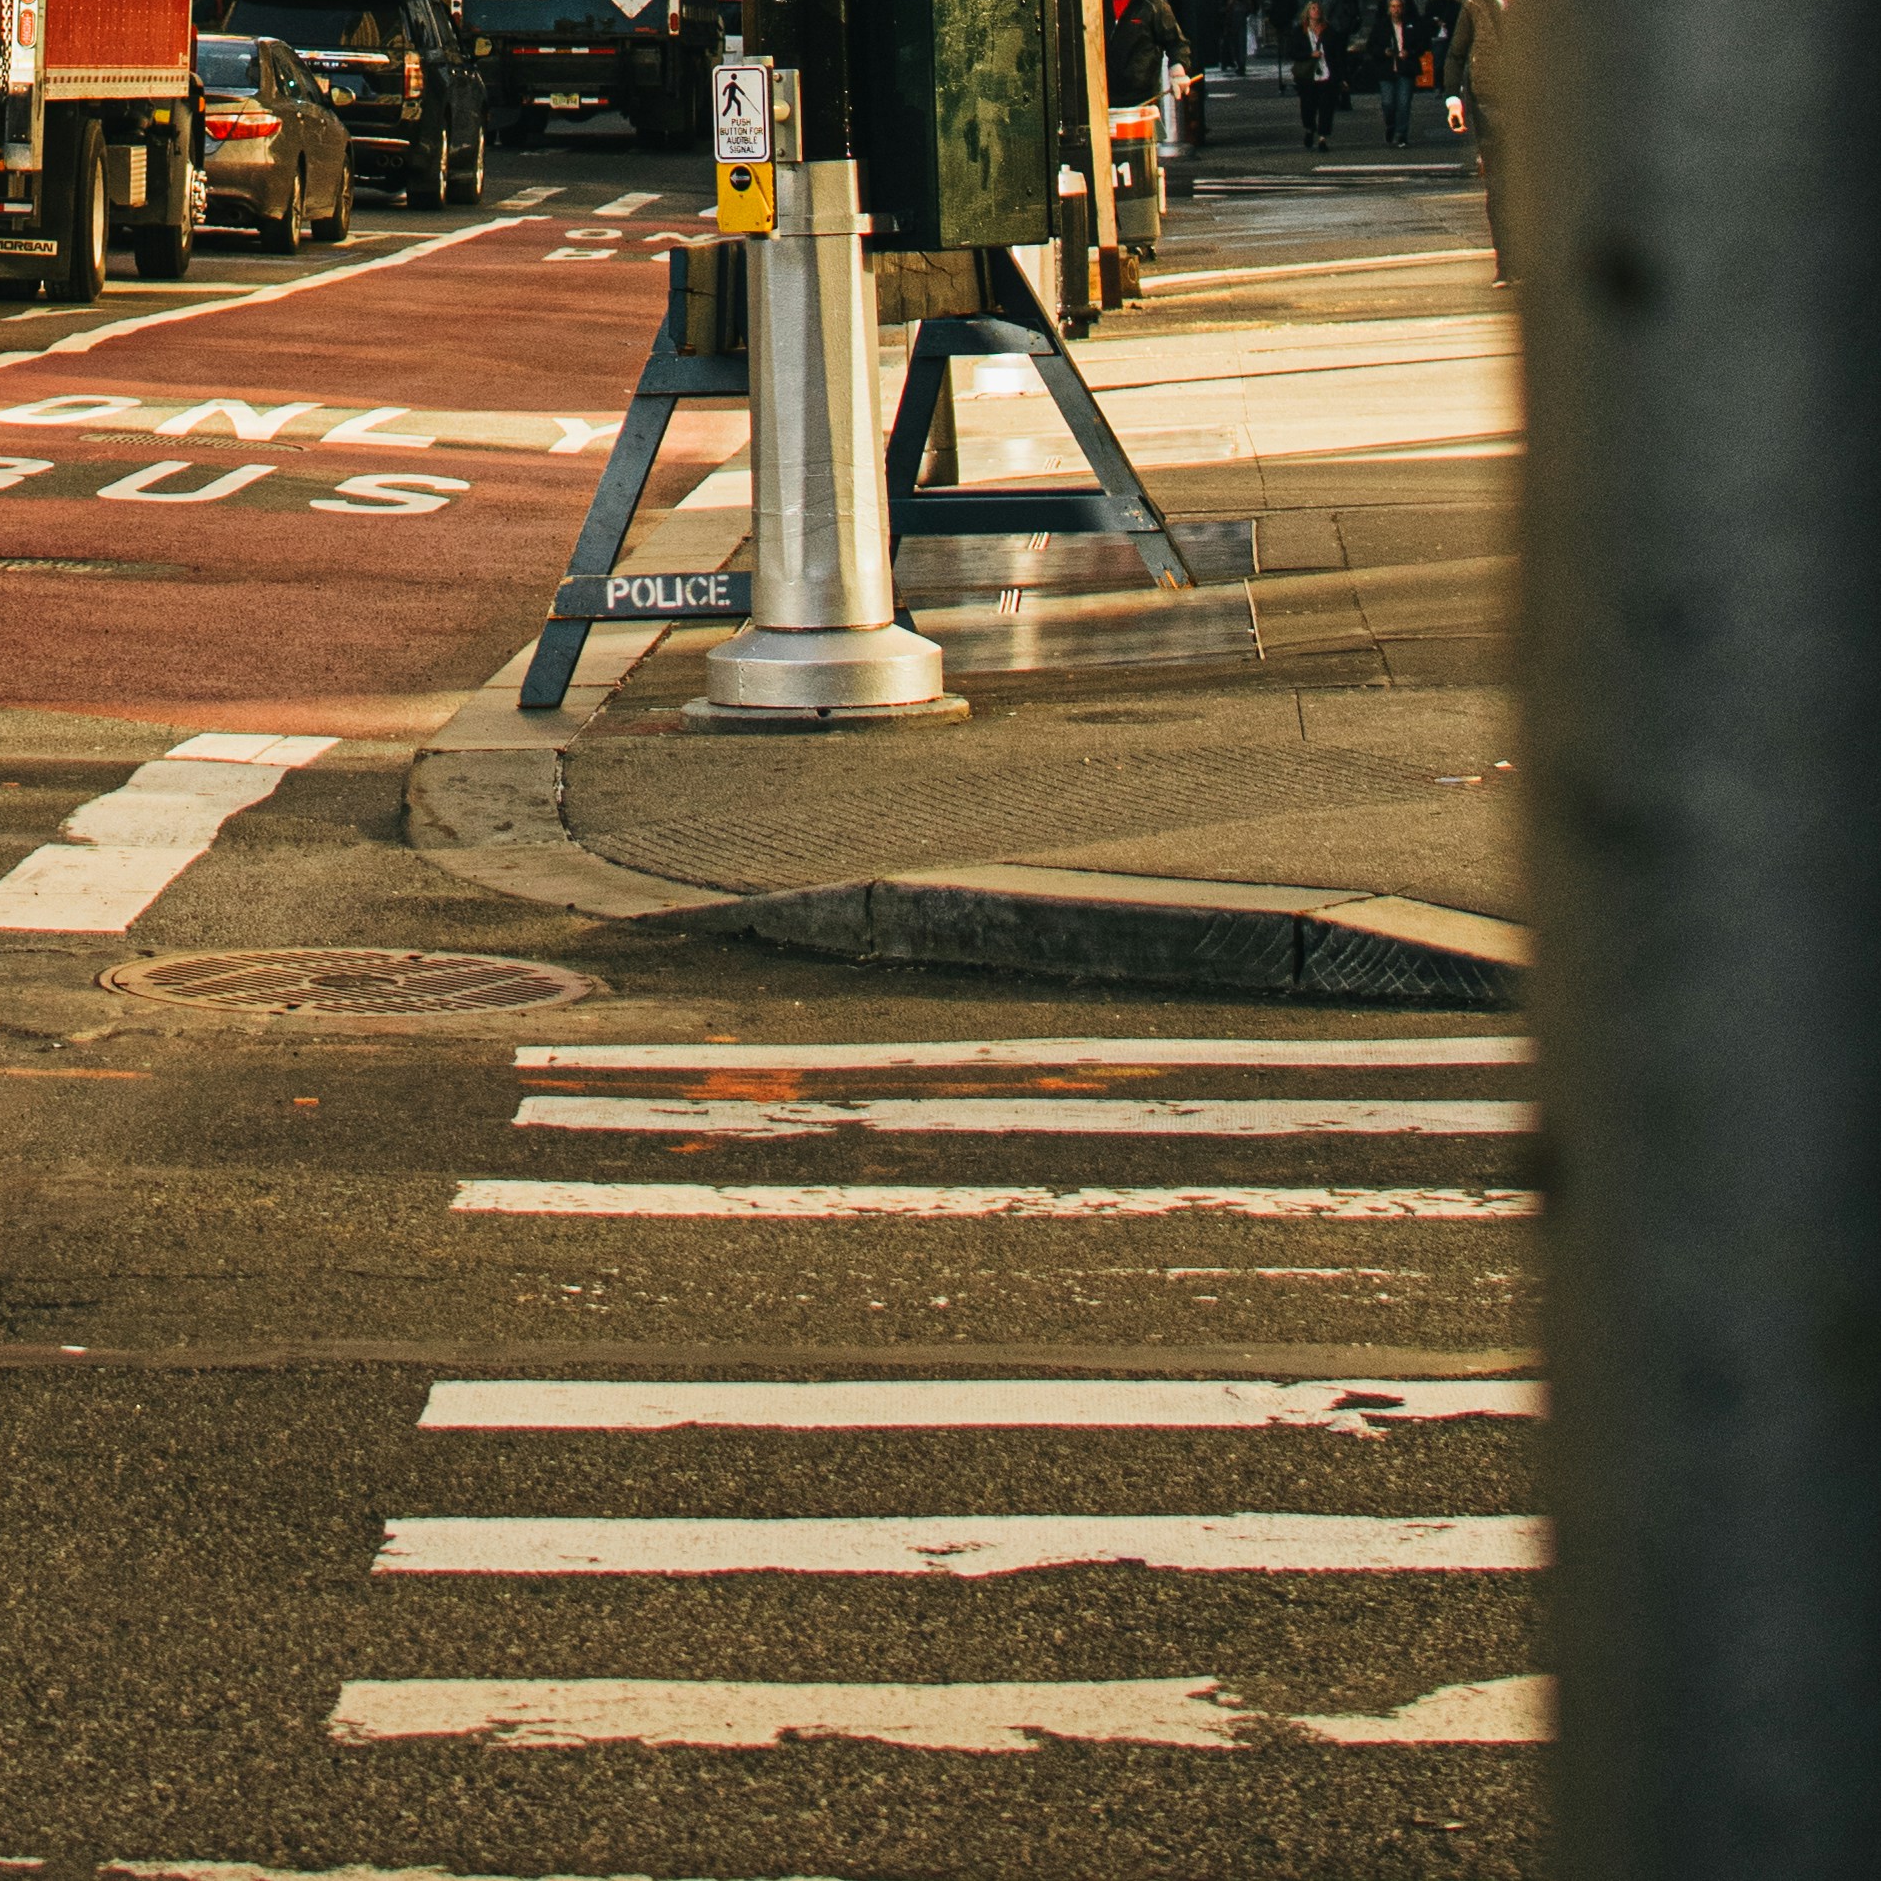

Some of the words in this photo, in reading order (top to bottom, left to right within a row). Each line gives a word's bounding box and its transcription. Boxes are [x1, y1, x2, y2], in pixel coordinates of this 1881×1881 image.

[731, 118, 752, 127] PUSH
[719, 127, 748, 136] BUTTON
[749, 127, 764, 136] FOR
[726, 136, 758, 145] AUDIBLE
[729, 146, 755, 154] SIGNAL
[606, 575, 731, 610] POLICE
